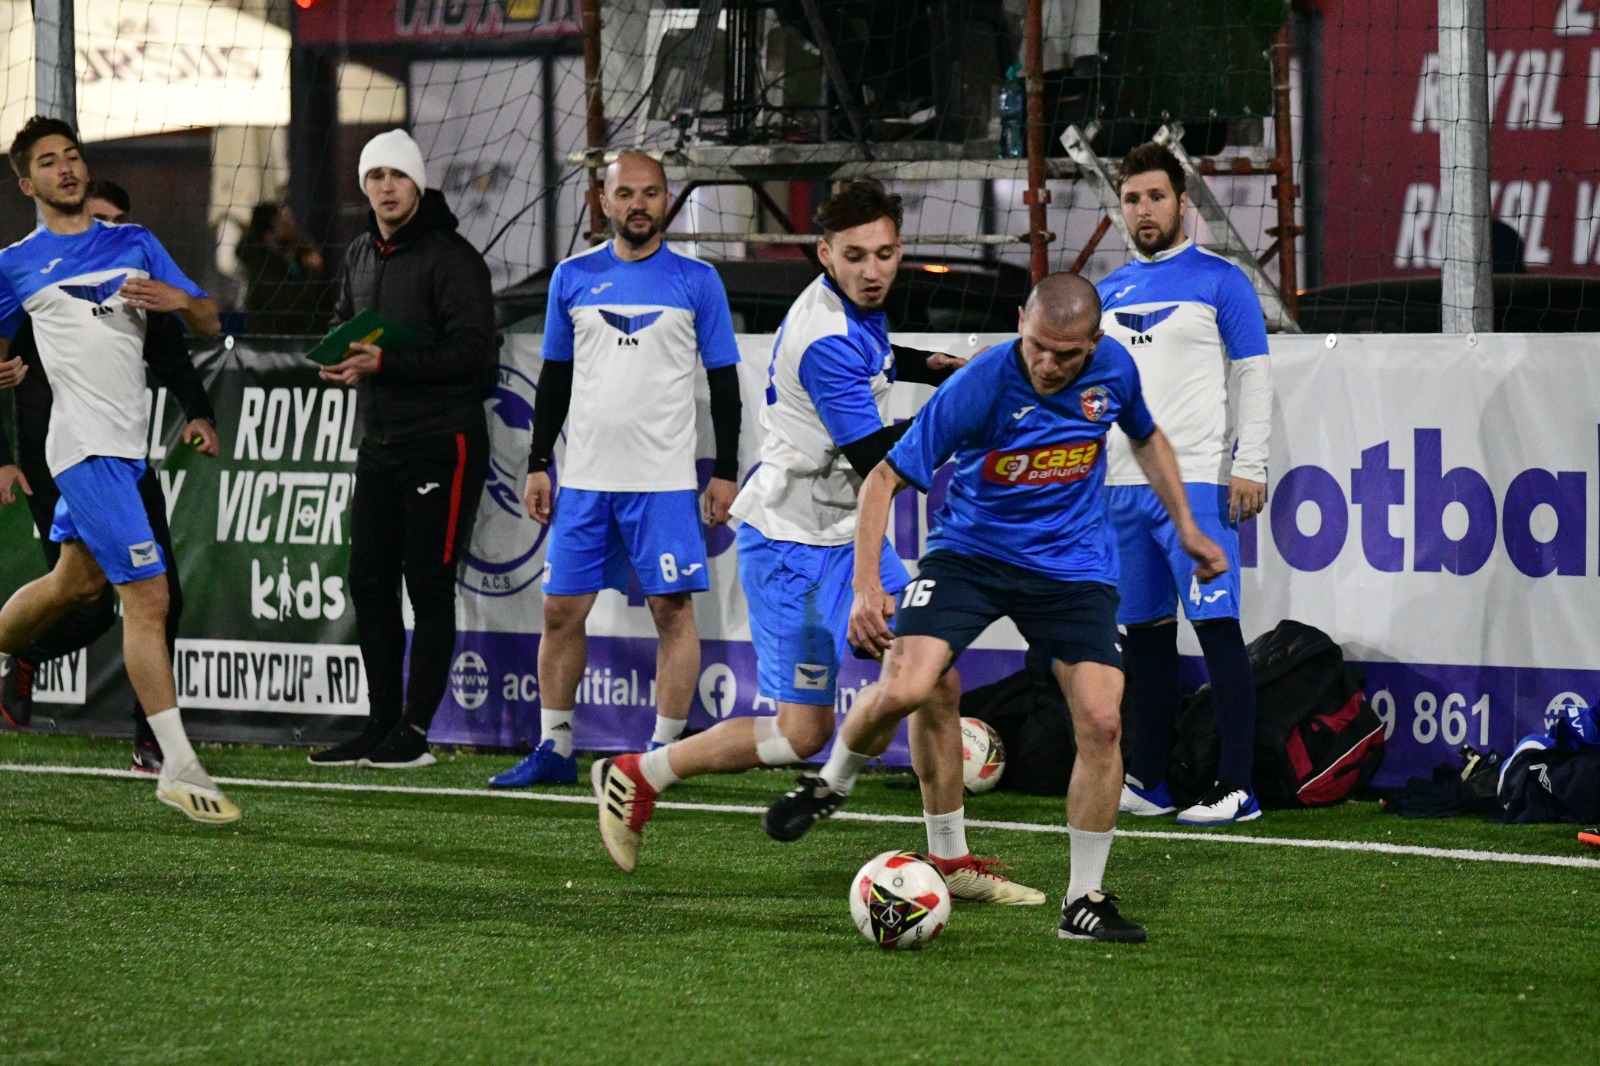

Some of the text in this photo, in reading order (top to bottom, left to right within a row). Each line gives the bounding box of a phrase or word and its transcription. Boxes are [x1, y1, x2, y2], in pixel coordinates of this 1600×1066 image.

[1411, 48, 1564, 133] RYAL
[91, 305, 115, 317] FAN
[617, 337, 640, 346] FAN
[1131, 334, 1153, 346] FAN
[233, 386, 359, 463] ROYAL
[1032, 443, 1098, 469] casa
[216, 469, 357, 546] VICTOR
[1232, 423, 1600, 578] otba
[659, 552, 679, 583] 8
[900, 579, 937, 609] 16
[1189, 574, 1202, 606] 4
[176, 649, 360, 704] ICTORYCUP.RO
[1371, 690, 1491, 746] 9 861
[961, 726, 988, 753] GIVO
